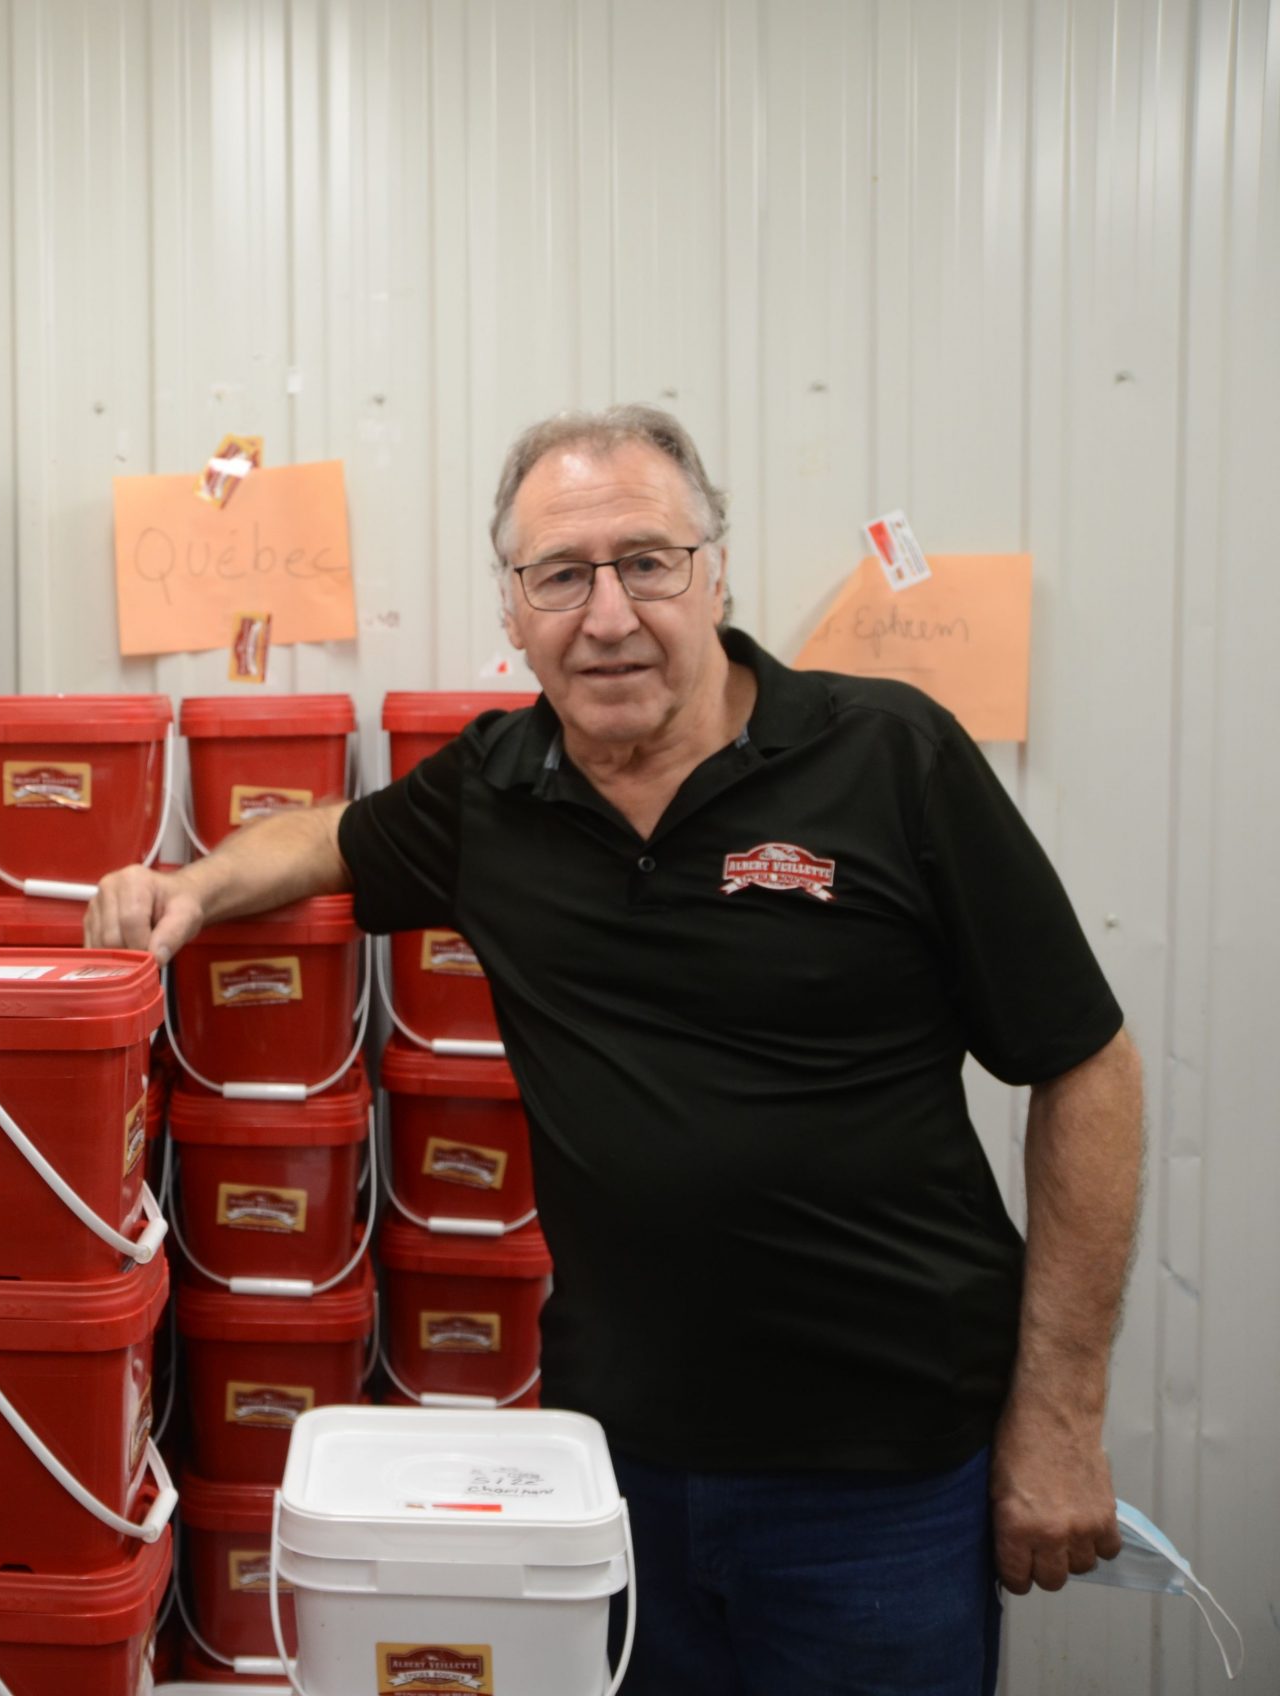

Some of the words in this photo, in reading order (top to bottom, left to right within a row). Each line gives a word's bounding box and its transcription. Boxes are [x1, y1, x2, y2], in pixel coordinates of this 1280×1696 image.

[133, 520, 348, 606] Québec
[728, 861, 770, 873] ALBERT
[772, 861, 833, 878] VEILLETTE
[391, 1659, 426, 1669] ALBERT
[428, 1660, 479, 1670] VEILLETTE
